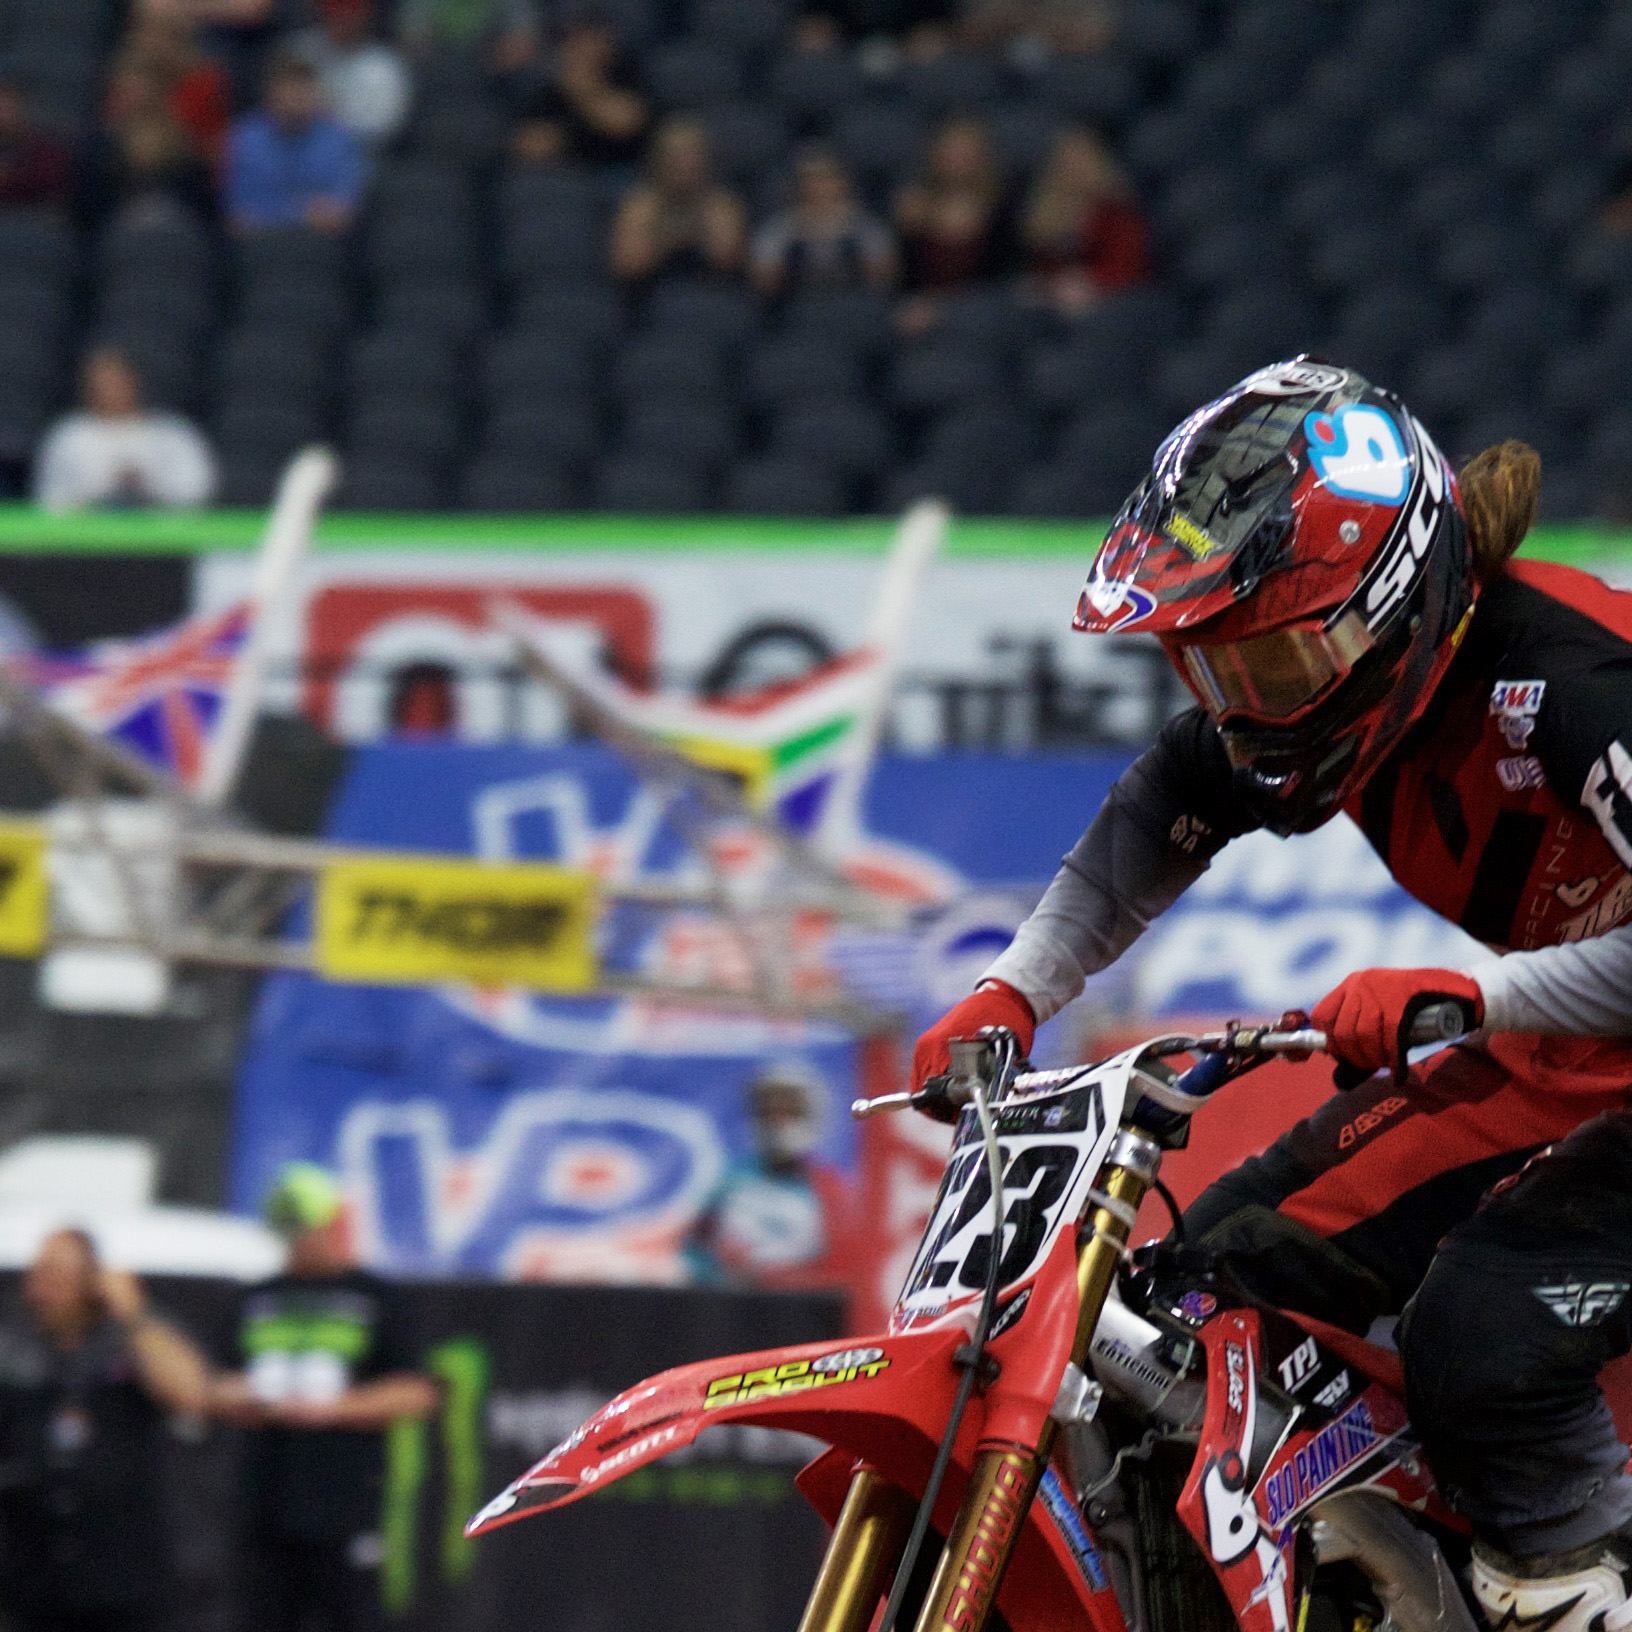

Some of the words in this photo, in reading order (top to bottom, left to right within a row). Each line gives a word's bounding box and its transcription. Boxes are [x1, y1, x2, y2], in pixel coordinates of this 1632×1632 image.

[1492, 684, 1541, 707] AMA
[346, 888, 570, 958] THOR
[706, 1360, 811, 1398] PRO
[1277, 1334, 1319, 1393] TPJ
